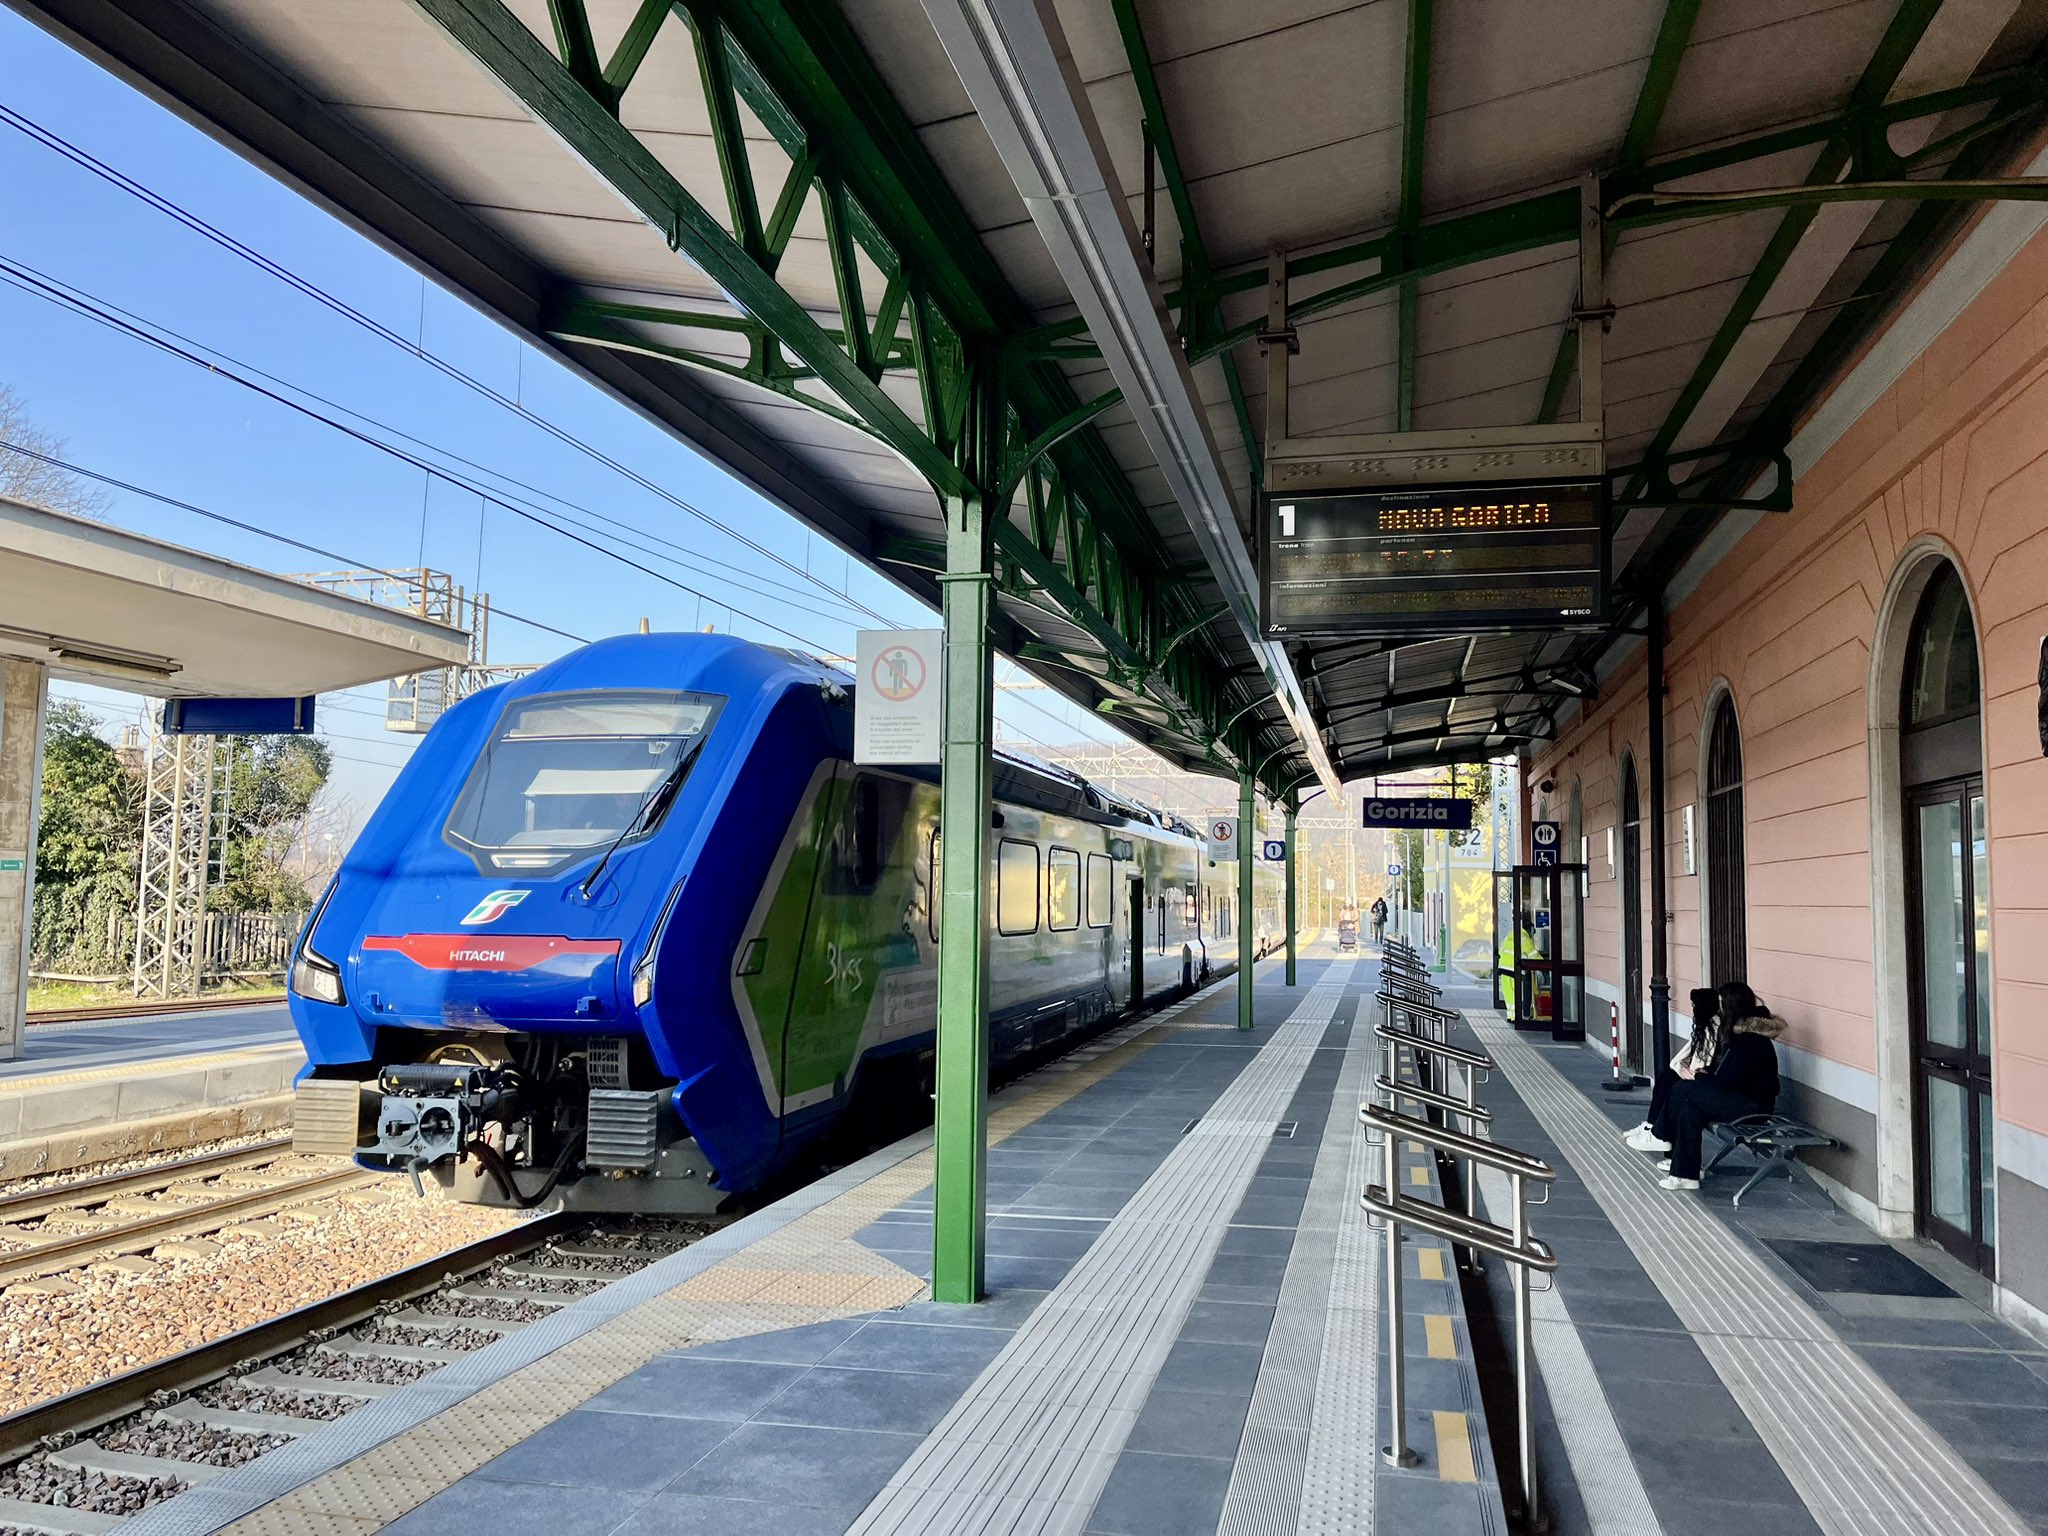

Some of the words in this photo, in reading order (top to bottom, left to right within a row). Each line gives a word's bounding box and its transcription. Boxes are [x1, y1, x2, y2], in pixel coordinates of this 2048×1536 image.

[1278, 505, 1295, 536] 1
[1452, 503, 1549, 527] GORICA
[1367, 802, 1448, 820] Gorizia
[1271, 845, 1276, 856] 1
[1461, 848, 1478, 857] 784
[449, 950, 505, 962] HITACHI
